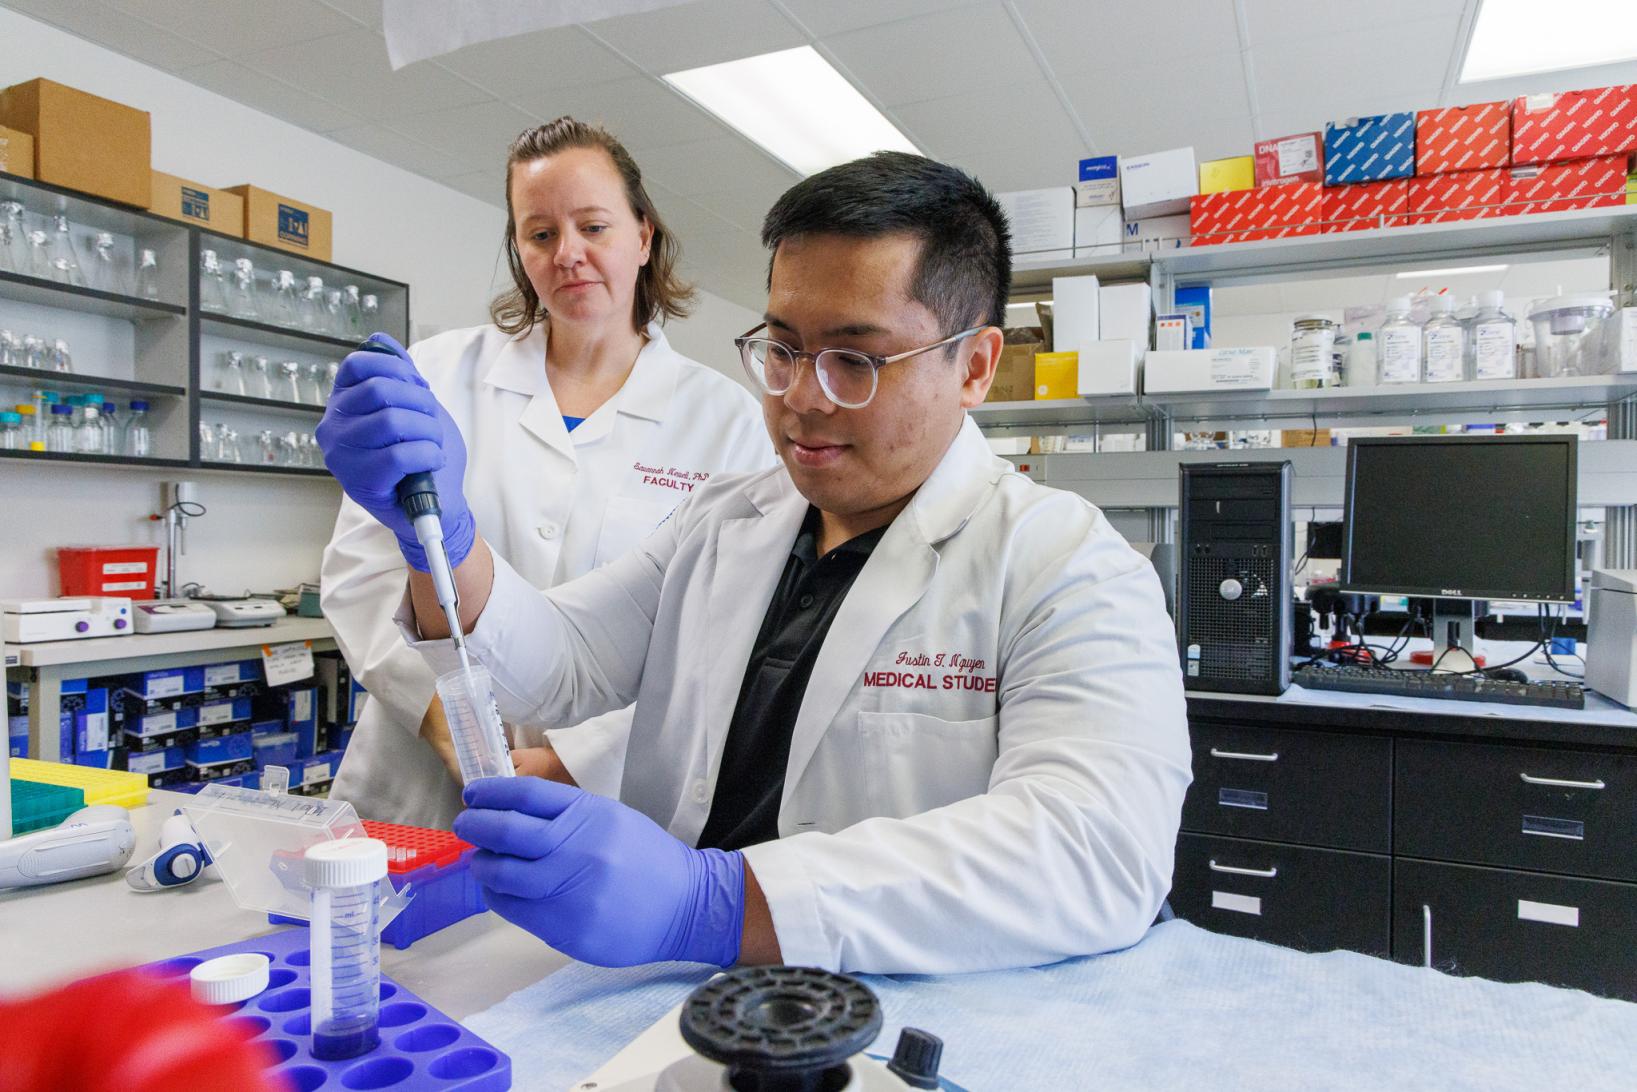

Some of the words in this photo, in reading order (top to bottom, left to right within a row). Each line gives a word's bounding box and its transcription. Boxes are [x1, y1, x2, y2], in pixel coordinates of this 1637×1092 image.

[643, 476, 694, 492] FACULTY
[949, 654, 985, 673] Nguyen
[864, 672, 937, 690] MEDICAL
